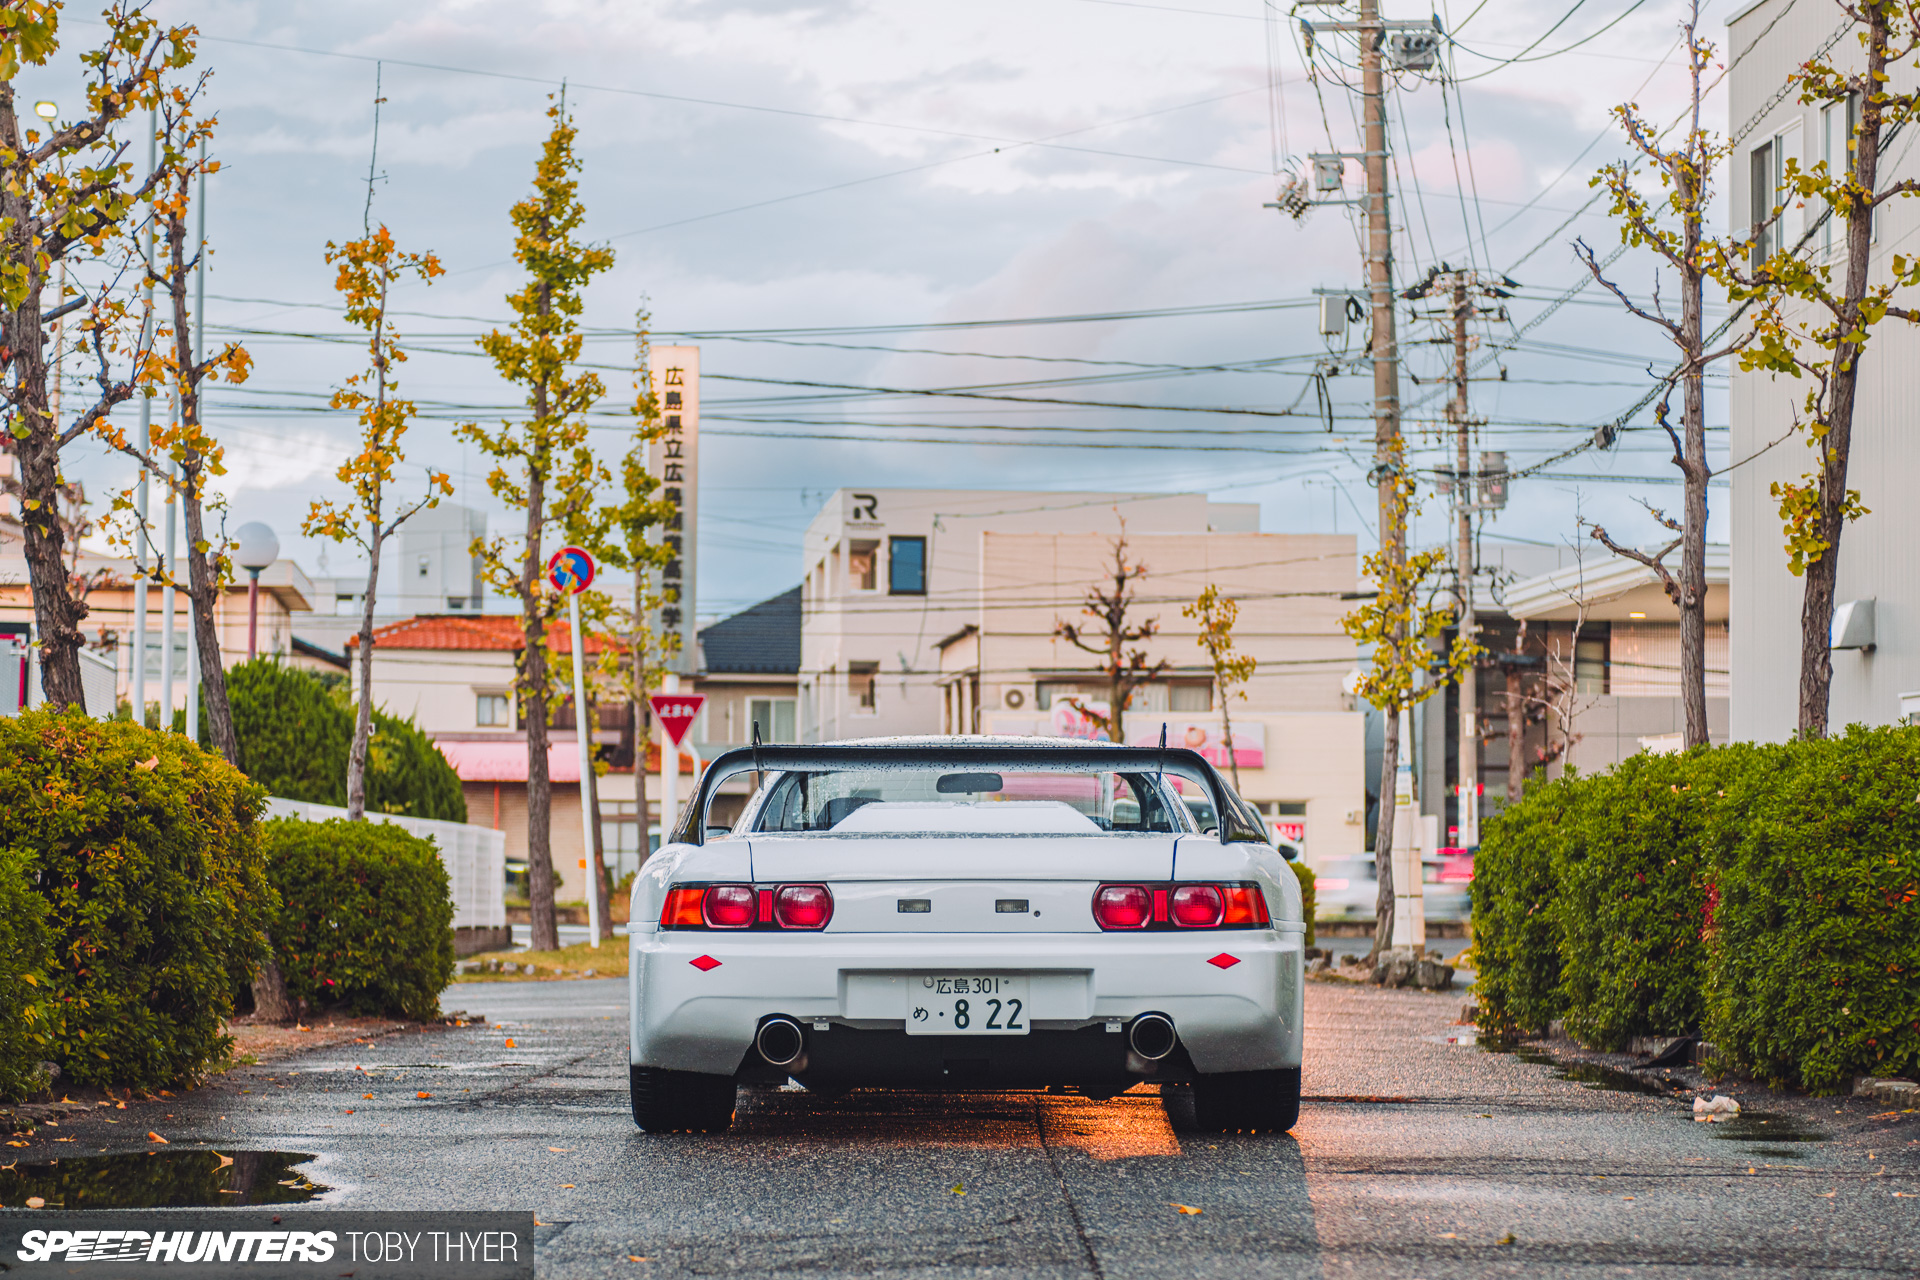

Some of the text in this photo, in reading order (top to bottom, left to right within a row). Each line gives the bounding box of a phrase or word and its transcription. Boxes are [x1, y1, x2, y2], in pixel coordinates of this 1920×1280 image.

[852, 493, 877, 520] R
[660, 703, 695, 717] 止まれ
